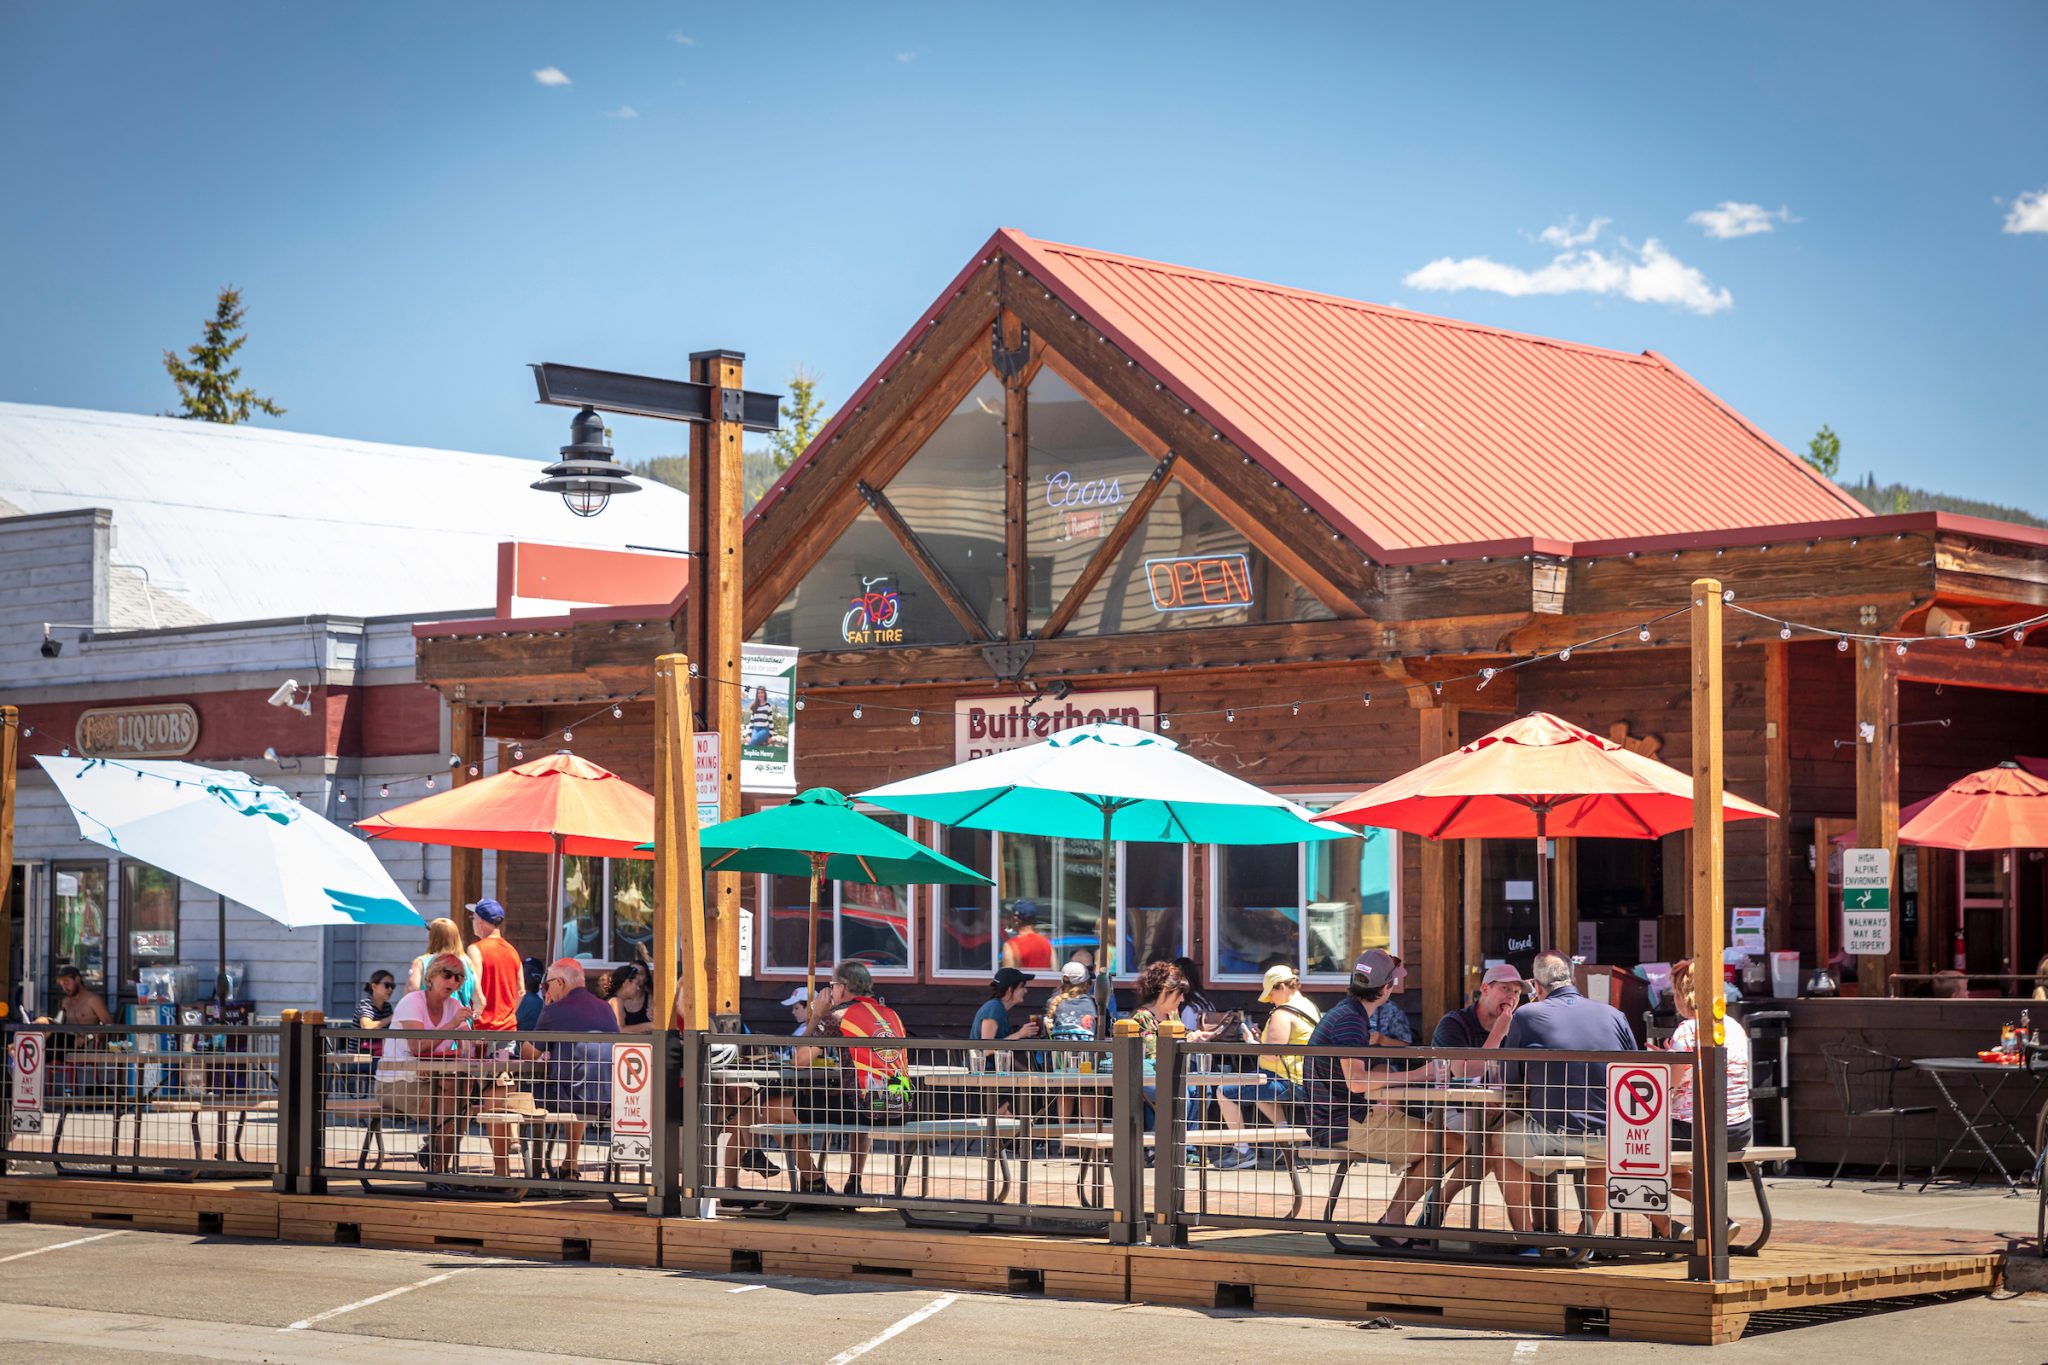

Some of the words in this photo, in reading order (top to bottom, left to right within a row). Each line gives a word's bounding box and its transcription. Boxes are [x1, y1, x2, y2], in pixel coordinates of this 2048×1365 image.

[1046, 470, 1124, 507] Coors
[1151, 559, 1250, 606] OPEN
[848, 631, 870, 644] FAT
[874, 629, 903, 642] TIRE
[969, 703, 1140, 739] Butterhorn
[118, 712, 192, 751] LIQUORS
[697, 740, 708, 752] NO
[694, 756, 717, 769] RKING
[1858, 854, 1875, 862] HIGH
[1854, 865, 1879, 874] ALPINE
[1845, 876, 1888, 886] ENVIRONMENT
[1848, 918, 1887, 927] WALKWAYS
[1853, 930, 1868, 938] MAY
[1872, 930, 1882, 938] BE
[1508, 934, 1533, 950] Closed
[1850, 941, 1886, 950] SLIPPERY
[22, 1077, 33, 1086] ANY
[21, 1086, 33, 1096] TIME
[625, 1096, 640, 1106] ANY
[624, 1107, 641, 1117] TIME
[1626, 1129, 1650, 1141] ANY
[1625, 1142, 1651, 1155] TIME
